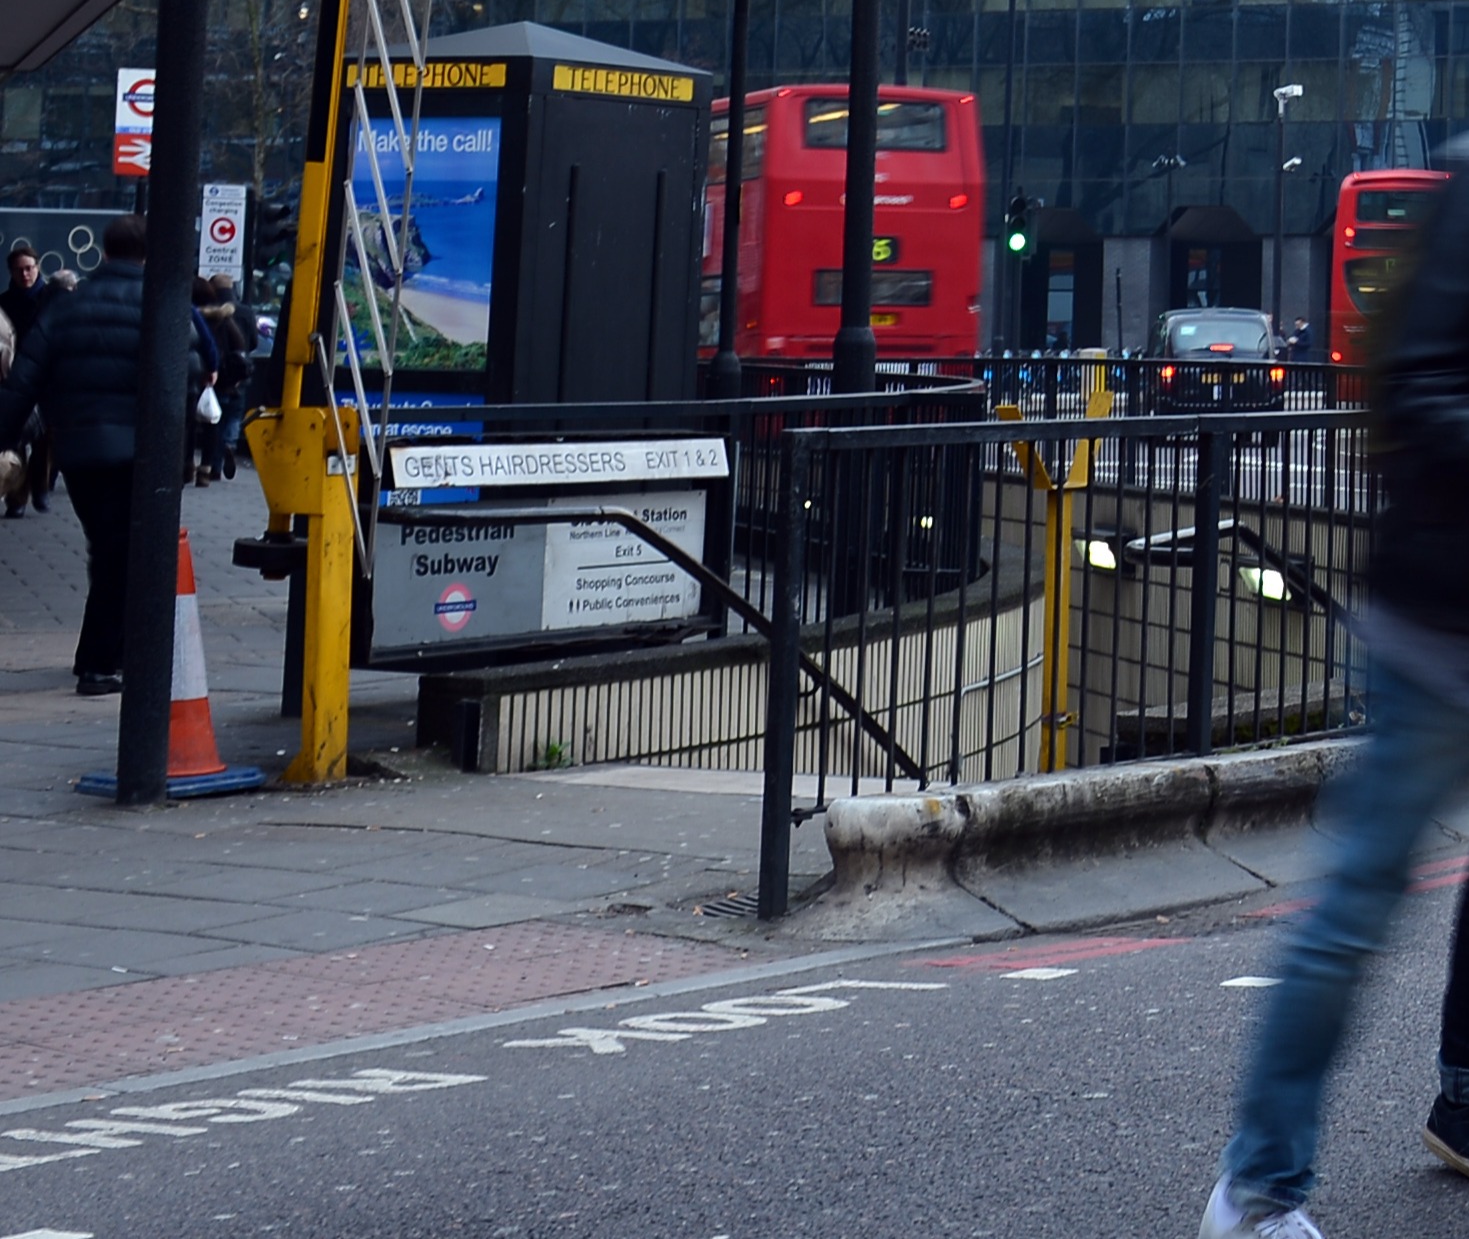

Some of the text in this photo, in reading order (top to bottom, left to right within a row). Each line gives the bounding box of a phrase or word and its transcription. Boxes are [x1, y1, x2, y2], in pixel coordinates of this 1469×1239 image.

[567, 67, 681, 99] TELEPHONE
[417, 129, 448, 152] the
[452, 129, 493, 152] call!
[205, 246, 237, 254] Central
[404, 449, 718, 478] GENTS HAIRDRESSERS EXIT 1 & 2
[642, 507, 688, 522] Station
[400, 523, 515, 546] Pedestrian
[570, 529, 602, 540] Northern
[605, 529, 620, 538] Line
[615, 544, 642, 558] Exit 5
[415, 552, 499, 577] Subway
[576, 572, 675, 591] Shopping Concourse
[582, 593, 681, 611] Public Conveniences
[503, 979, 951, 1054] LOOK
